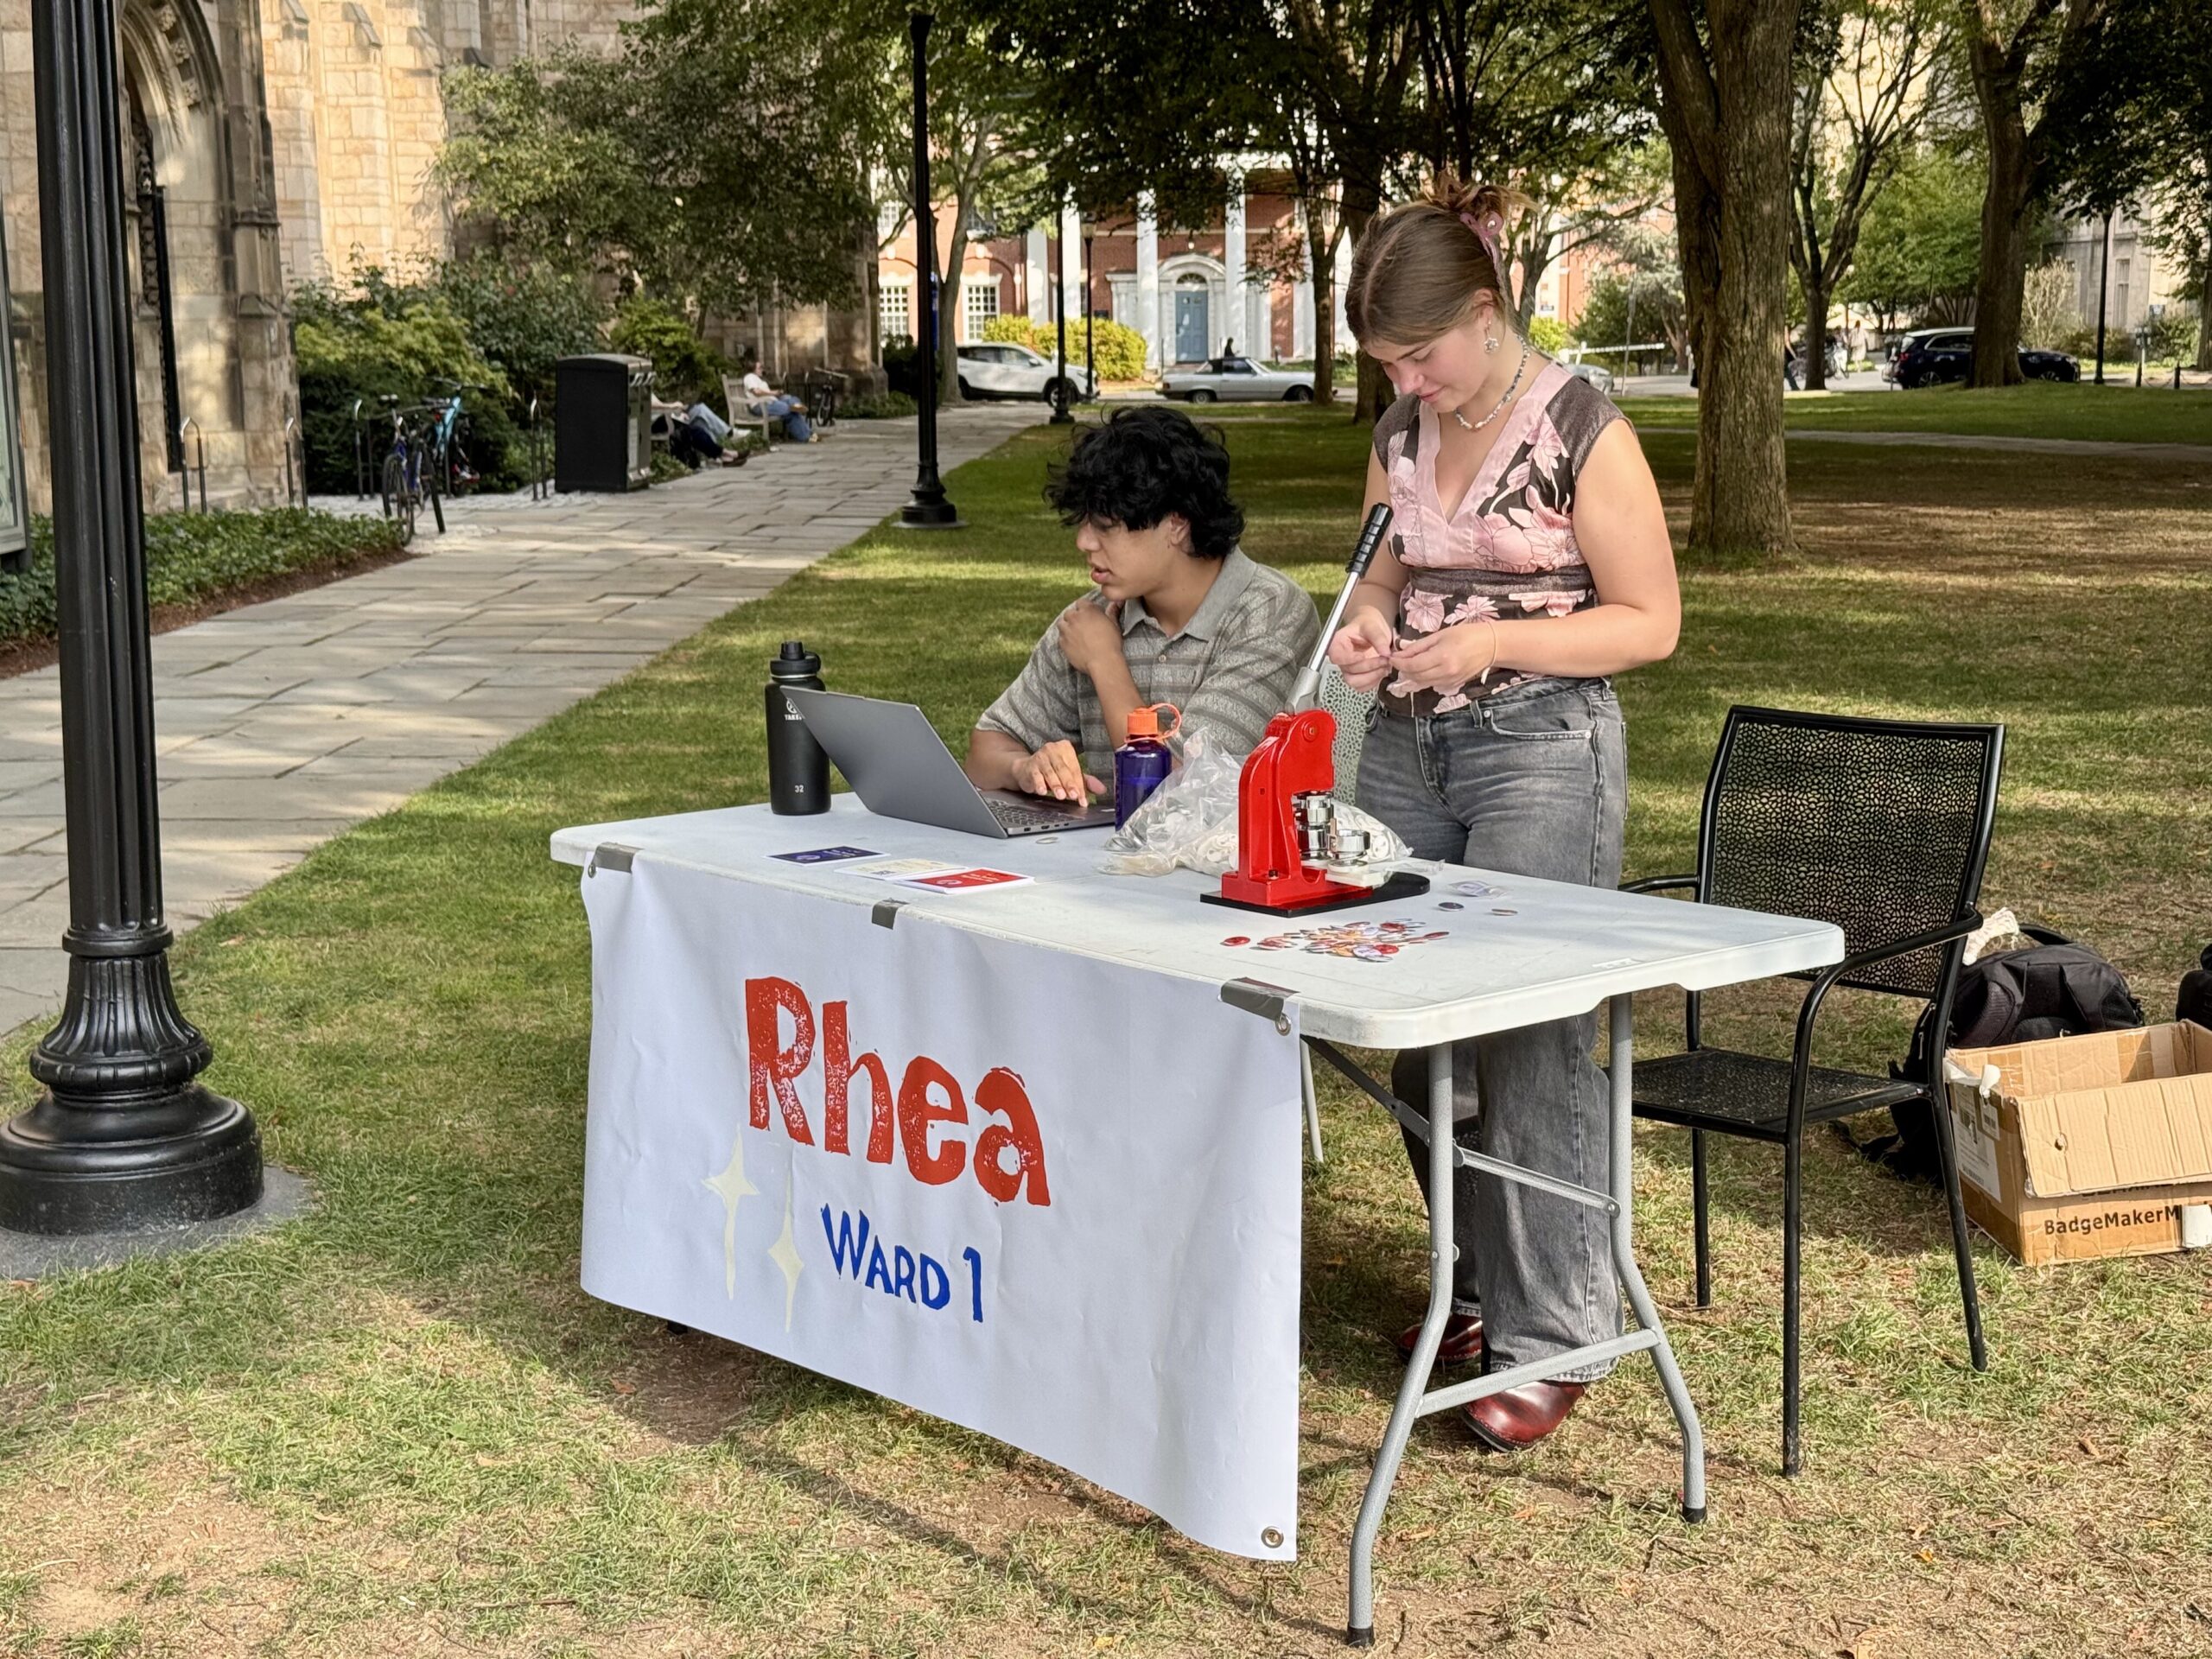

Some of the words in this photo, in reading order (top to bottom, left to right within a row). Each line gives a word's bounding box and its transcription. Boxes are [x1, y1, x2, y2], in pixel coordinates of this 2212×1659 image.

[794, 785, 804, 793] 32
[745, 976, 1052, 1207] Rhea
[2044, 1204, 2183, 1236] BadgeMakerM
[820, 1202, 951, 1311] WARD
[963, 1246, 984, 1324] 1
